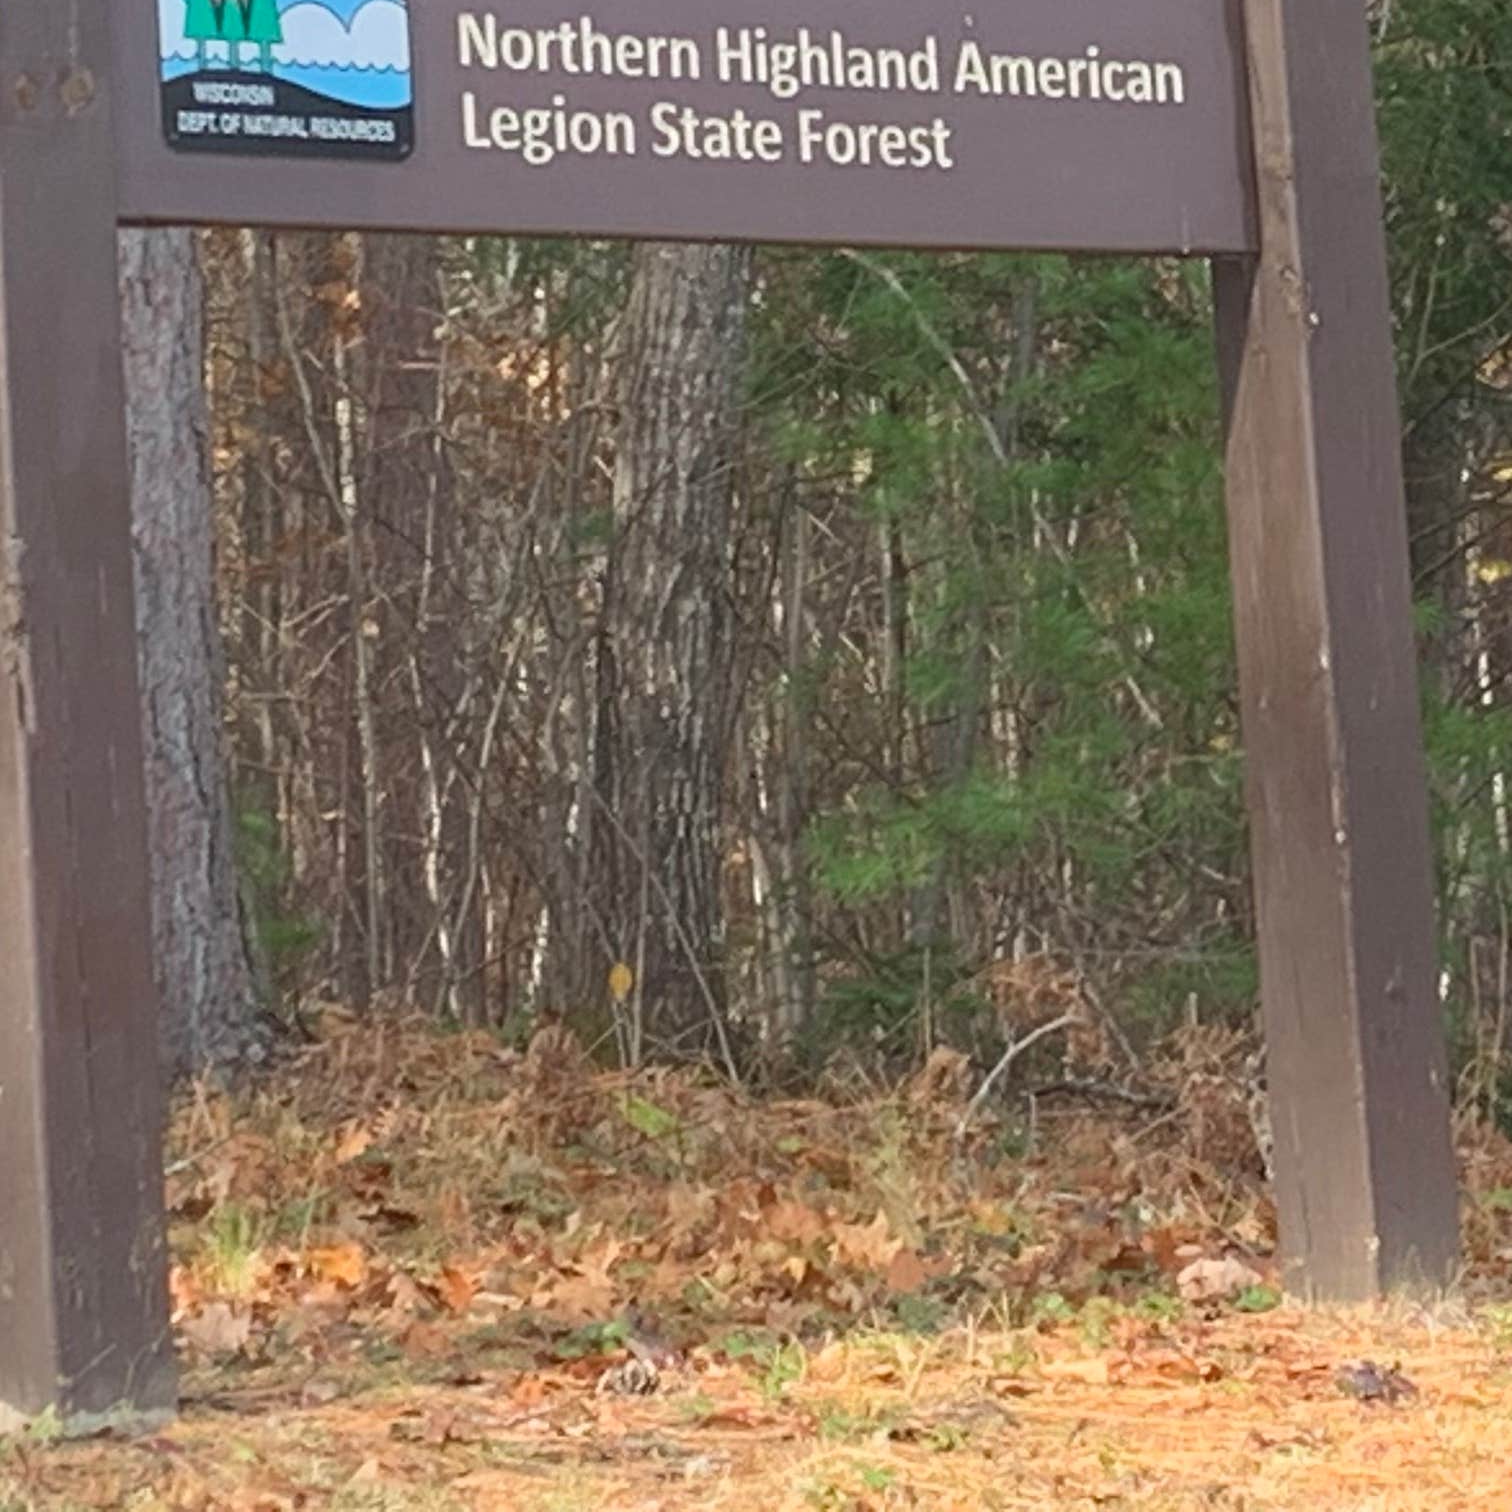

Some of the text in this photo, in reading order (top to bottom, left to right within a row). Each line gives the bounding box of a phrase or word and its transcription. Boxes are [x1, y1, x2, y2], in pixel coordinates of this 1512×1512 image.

[457, 12, 1185, 104] Northern Highland American
[220, 112, 241, 135] OF
[243, 114, 308, 138] NATURAL
[309, 117, 395, 142] RESOURCES
[461, 91, 954, 170] Legion State Forest
